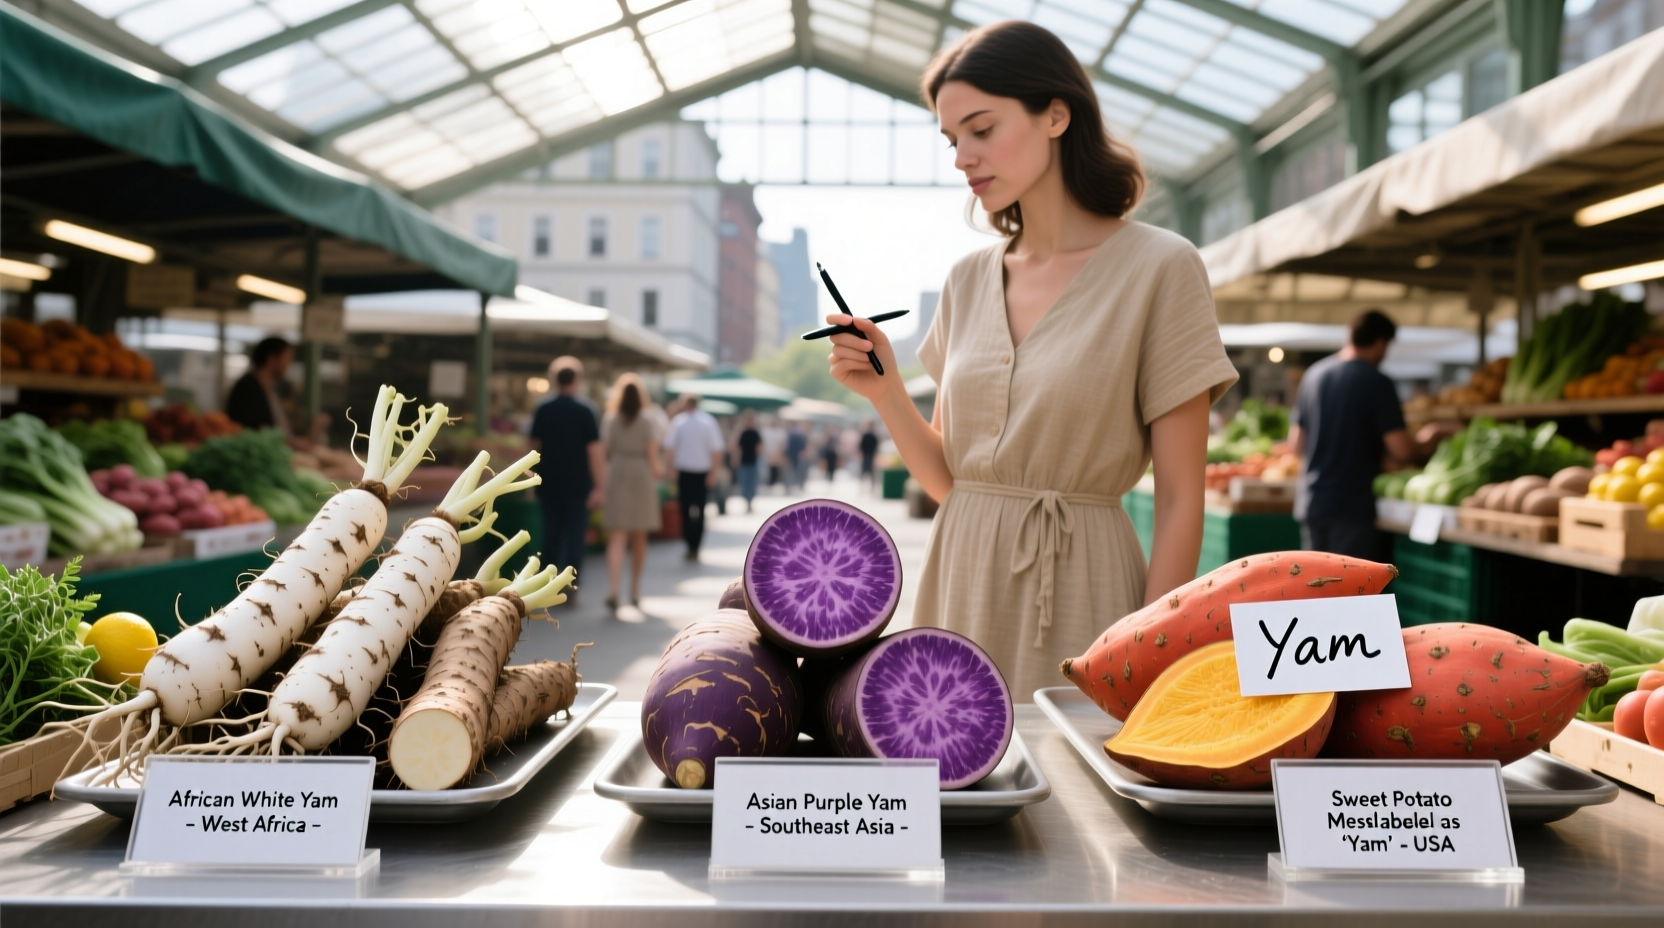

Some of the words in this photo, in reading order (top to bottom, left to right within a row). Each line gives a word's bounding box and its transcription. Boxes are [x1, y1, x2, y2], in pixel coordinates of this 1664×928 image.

[1258, 616, 1382, 680] Yam
[168, 789, 235, 808] African
[241, 790, 295, 808] White
[300, 791, 339, 809] Yam
[746, 792, 798, 811] Asian
[804, 792, 863, 815] Purple
[867, 793, 907, 811] Yam
[1331, 789, 1389, 808] Sweet
[1392, 790, 1453, 808] Potato
[201, 814, 249, 833] West
[252, 814, 307, 833] Africa
[760, 816, 850, 835] Southeast
[855, 817, 895, 835] Asia
[1440, 817, 1461, 830] as
[1413, 834, 1456, 853] USA
